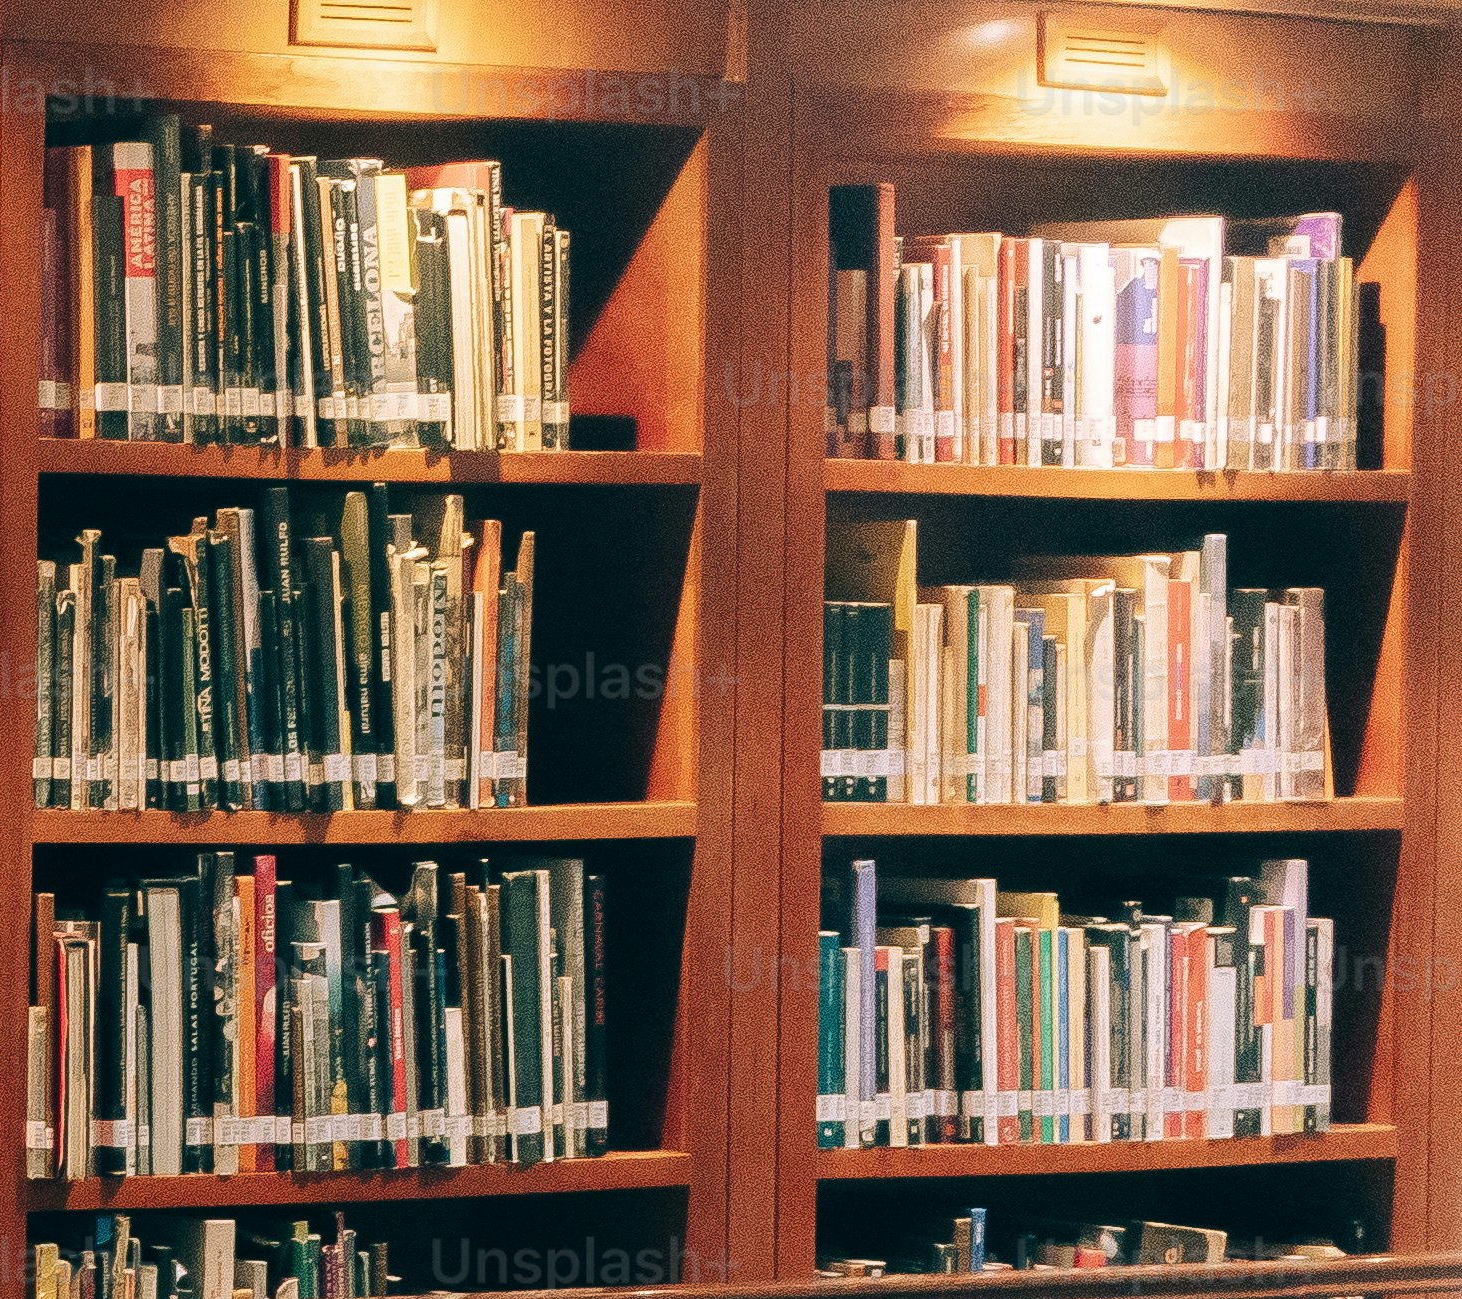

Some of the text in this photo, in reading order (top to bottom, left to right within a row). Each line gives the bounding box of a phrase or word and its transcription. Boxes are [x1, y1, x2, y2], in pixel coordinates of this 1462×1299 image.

[128, 178, 143, 267] AMÉRICA
[278, 521, 291, 603] JUAN RULFO
[195, 607, 212, 722] TINA MODOTTI
[358, 653, 371, 734] alma natural
[262, 894, 275, 952] oficios
[190, 941, 198, 1052] SALAS PORTUGAL
